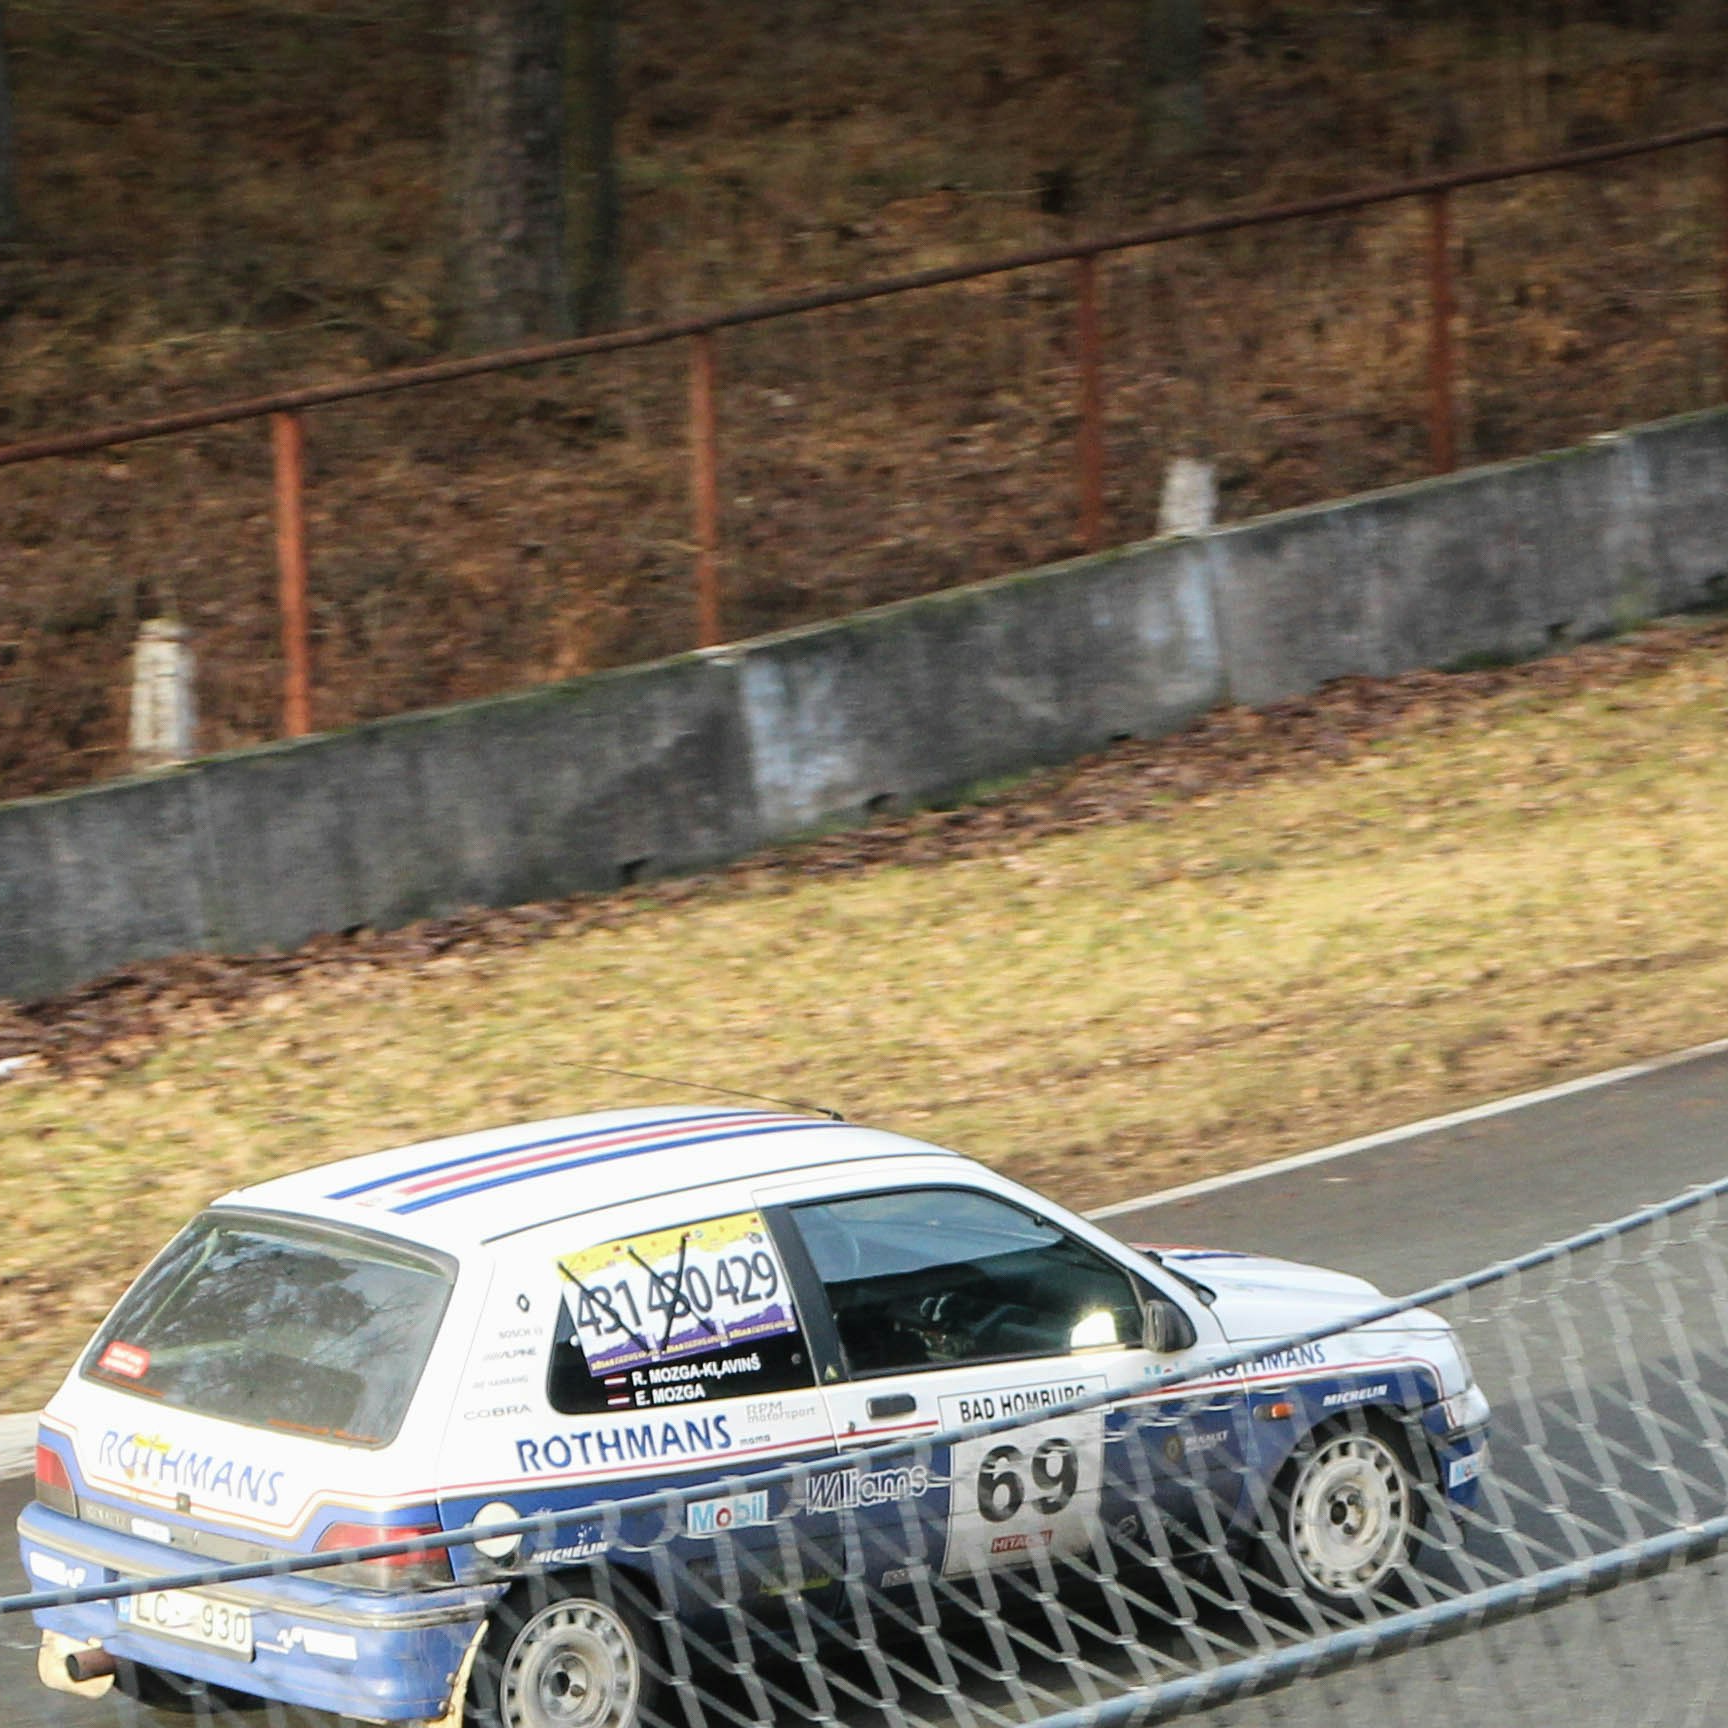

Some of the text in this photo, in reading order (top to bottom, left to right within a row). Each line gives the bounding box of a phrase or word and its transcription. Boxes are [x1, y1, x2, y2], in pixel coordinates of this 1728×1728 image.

[716, 1251, 779, 1306] 429
[632, 1370, 648, 1387] R.
[634, 1384, 706, 1407] E. MOZGA
[958, 1396, 995, 1423] BAD
[1322, 1383, 1389, 1407] MICHELIN
[464, 1404, 532, 1421] COBRA
[515, 1414, 732, 1473] ROTHMANS
[98, 1430, 286, 1507] ROTHMANS
[977, 1437, 1079, 1523] 69
[691, 1494, 765, 1532] Mobil
[530, 1541, 609, 1563] MICHELIN
[202, 1604, 248, 1645] 930
